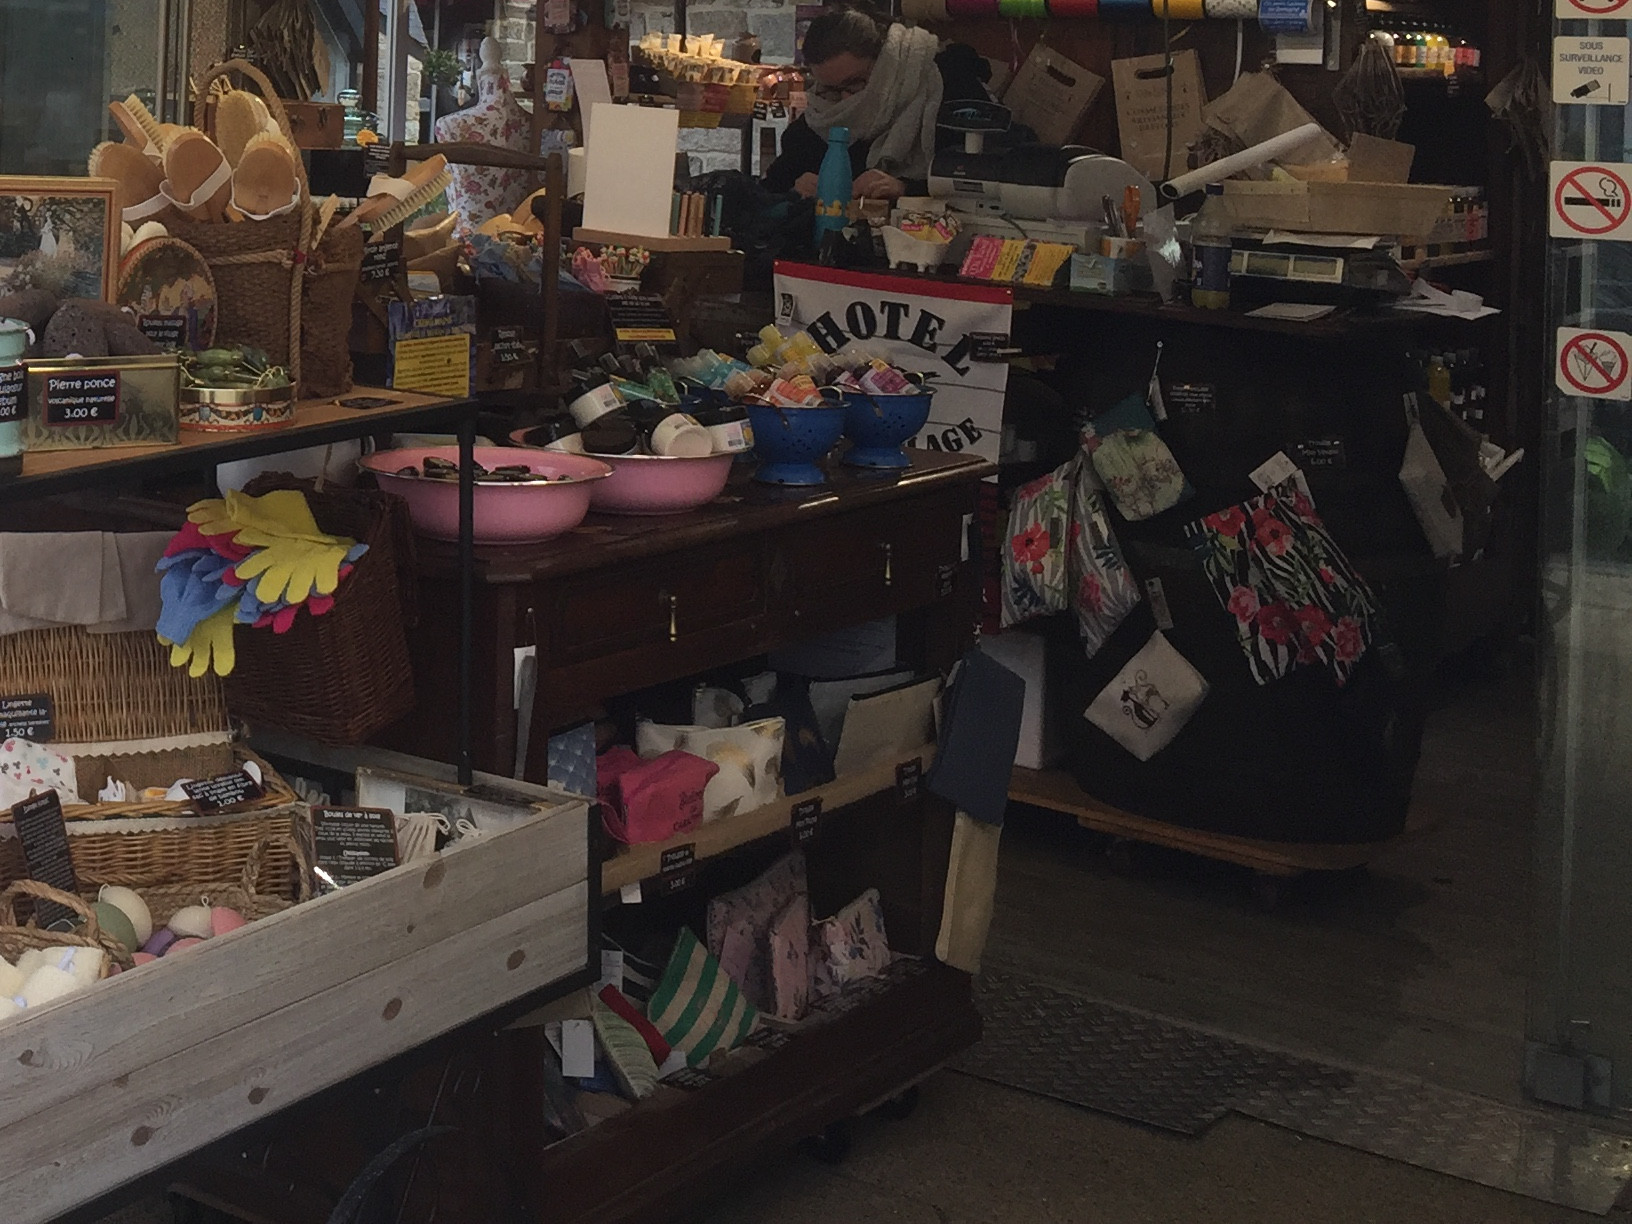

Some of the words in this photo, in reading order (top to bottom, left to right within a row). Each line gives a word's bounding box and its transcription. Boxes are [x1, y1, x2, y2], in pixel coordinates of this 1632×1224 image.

[1579, 41, 1603, 50] SOUS
[1559, 53, 1623, 63] SURVEILLANCE
[1578, 66, 1604, 75] VIDEO
[806, 300, 972, 377] HOTEL
[48, 379, 81, 391] Pierre
[83, 378, 115, 390] ponce
[64, 408, 88, 418] 3.00
[90, 407, 98, 417] €
